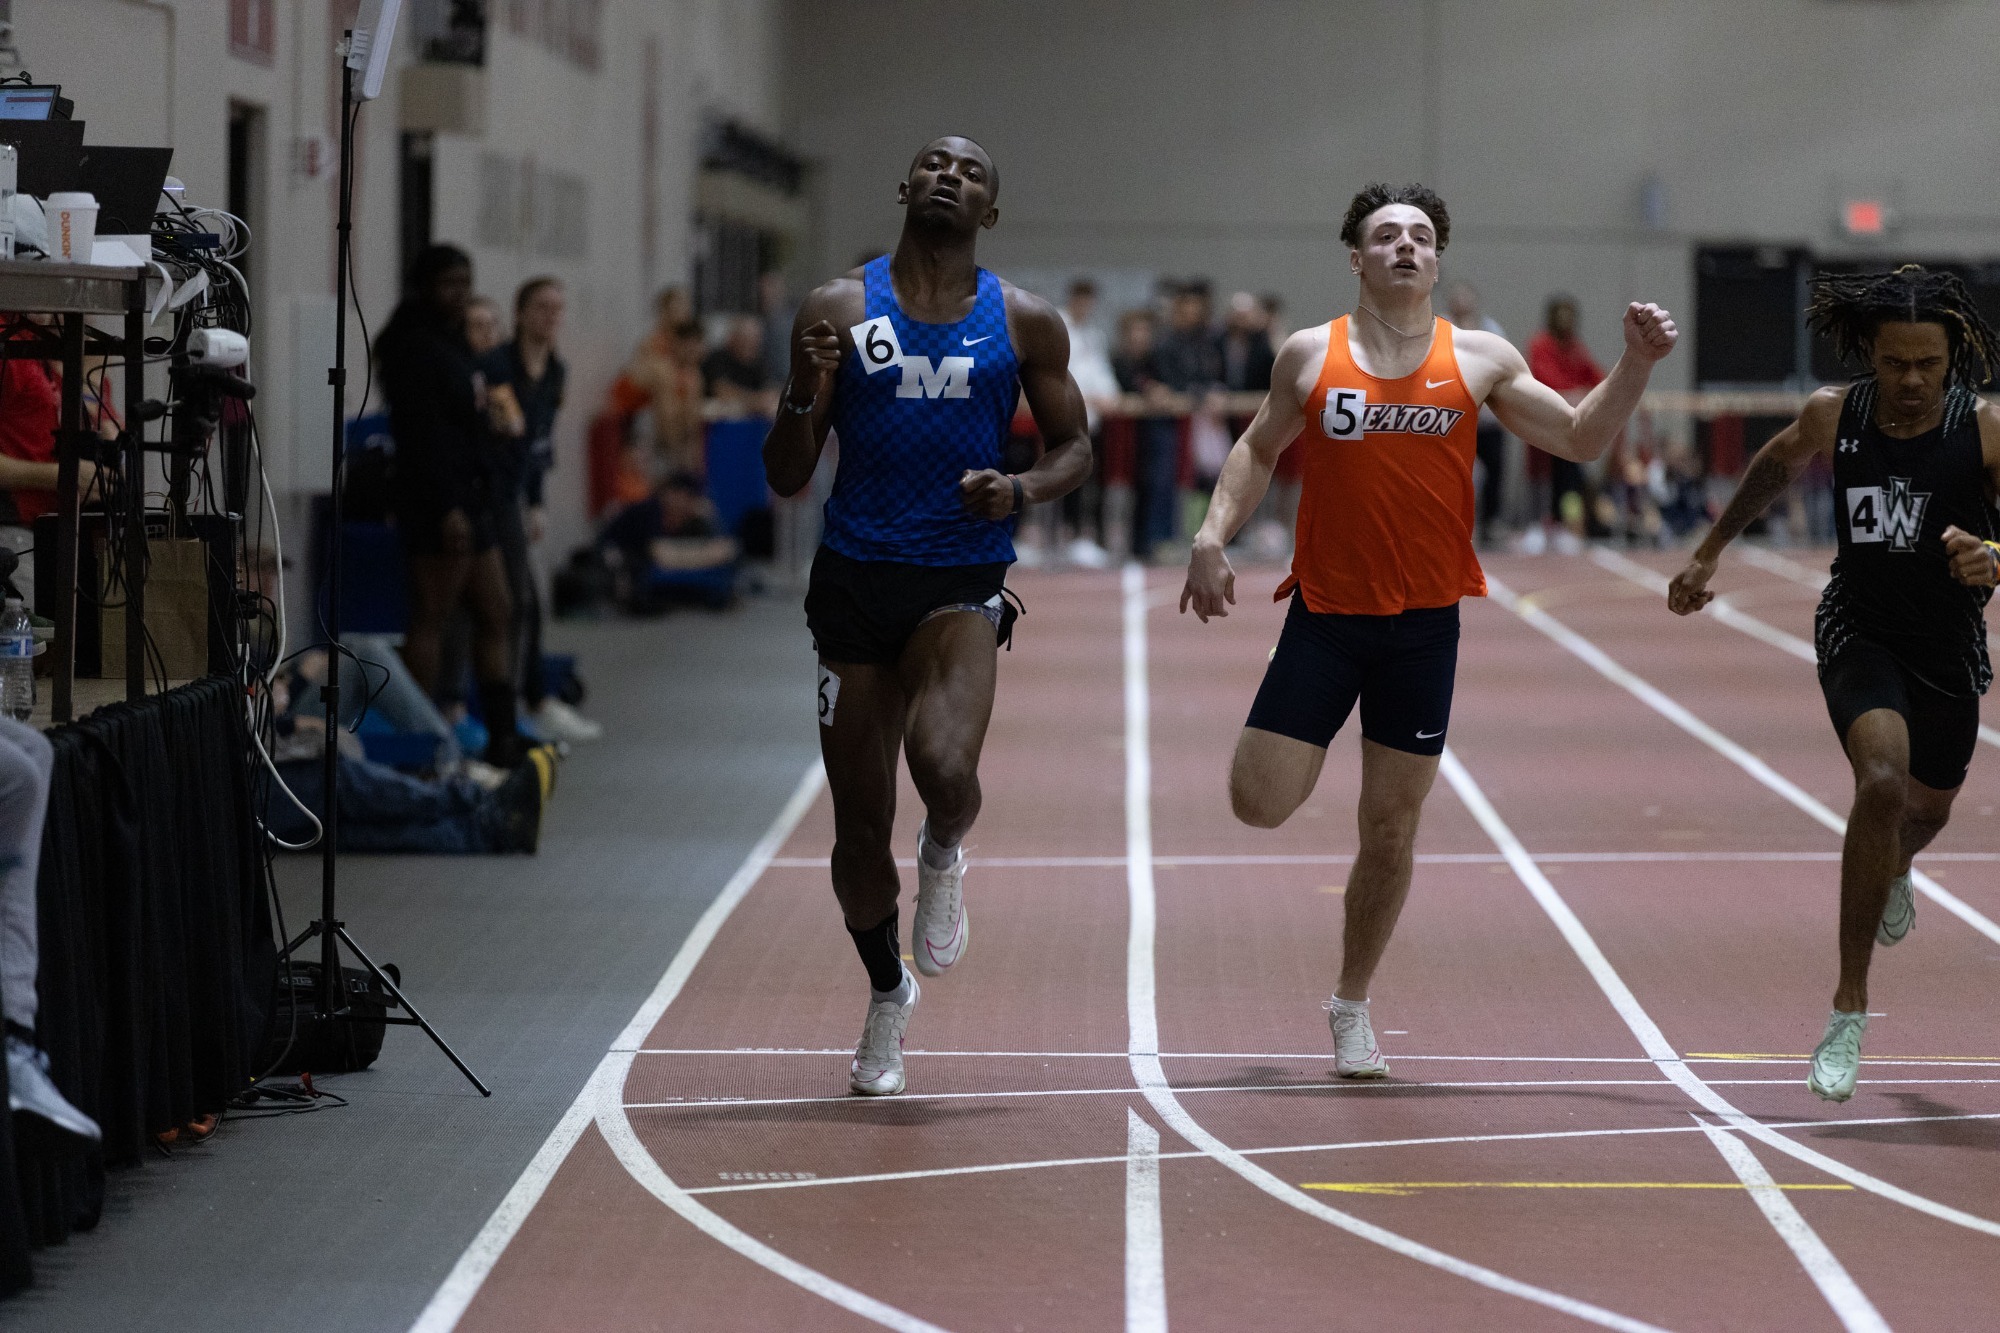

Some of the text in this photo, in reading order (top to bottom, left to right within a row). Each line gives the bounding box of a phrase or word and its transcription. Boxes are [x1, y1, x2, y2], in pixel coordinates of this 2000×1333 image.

[865, 324, 895, 365] 6
[895, 355, 975, 399] M
[1321, 404, 1465, 437] EATON
[1332, 392, 1357, 436] 5
[1851, 495, 1878, 534] 4
[818, 675, 831, 718] 6
